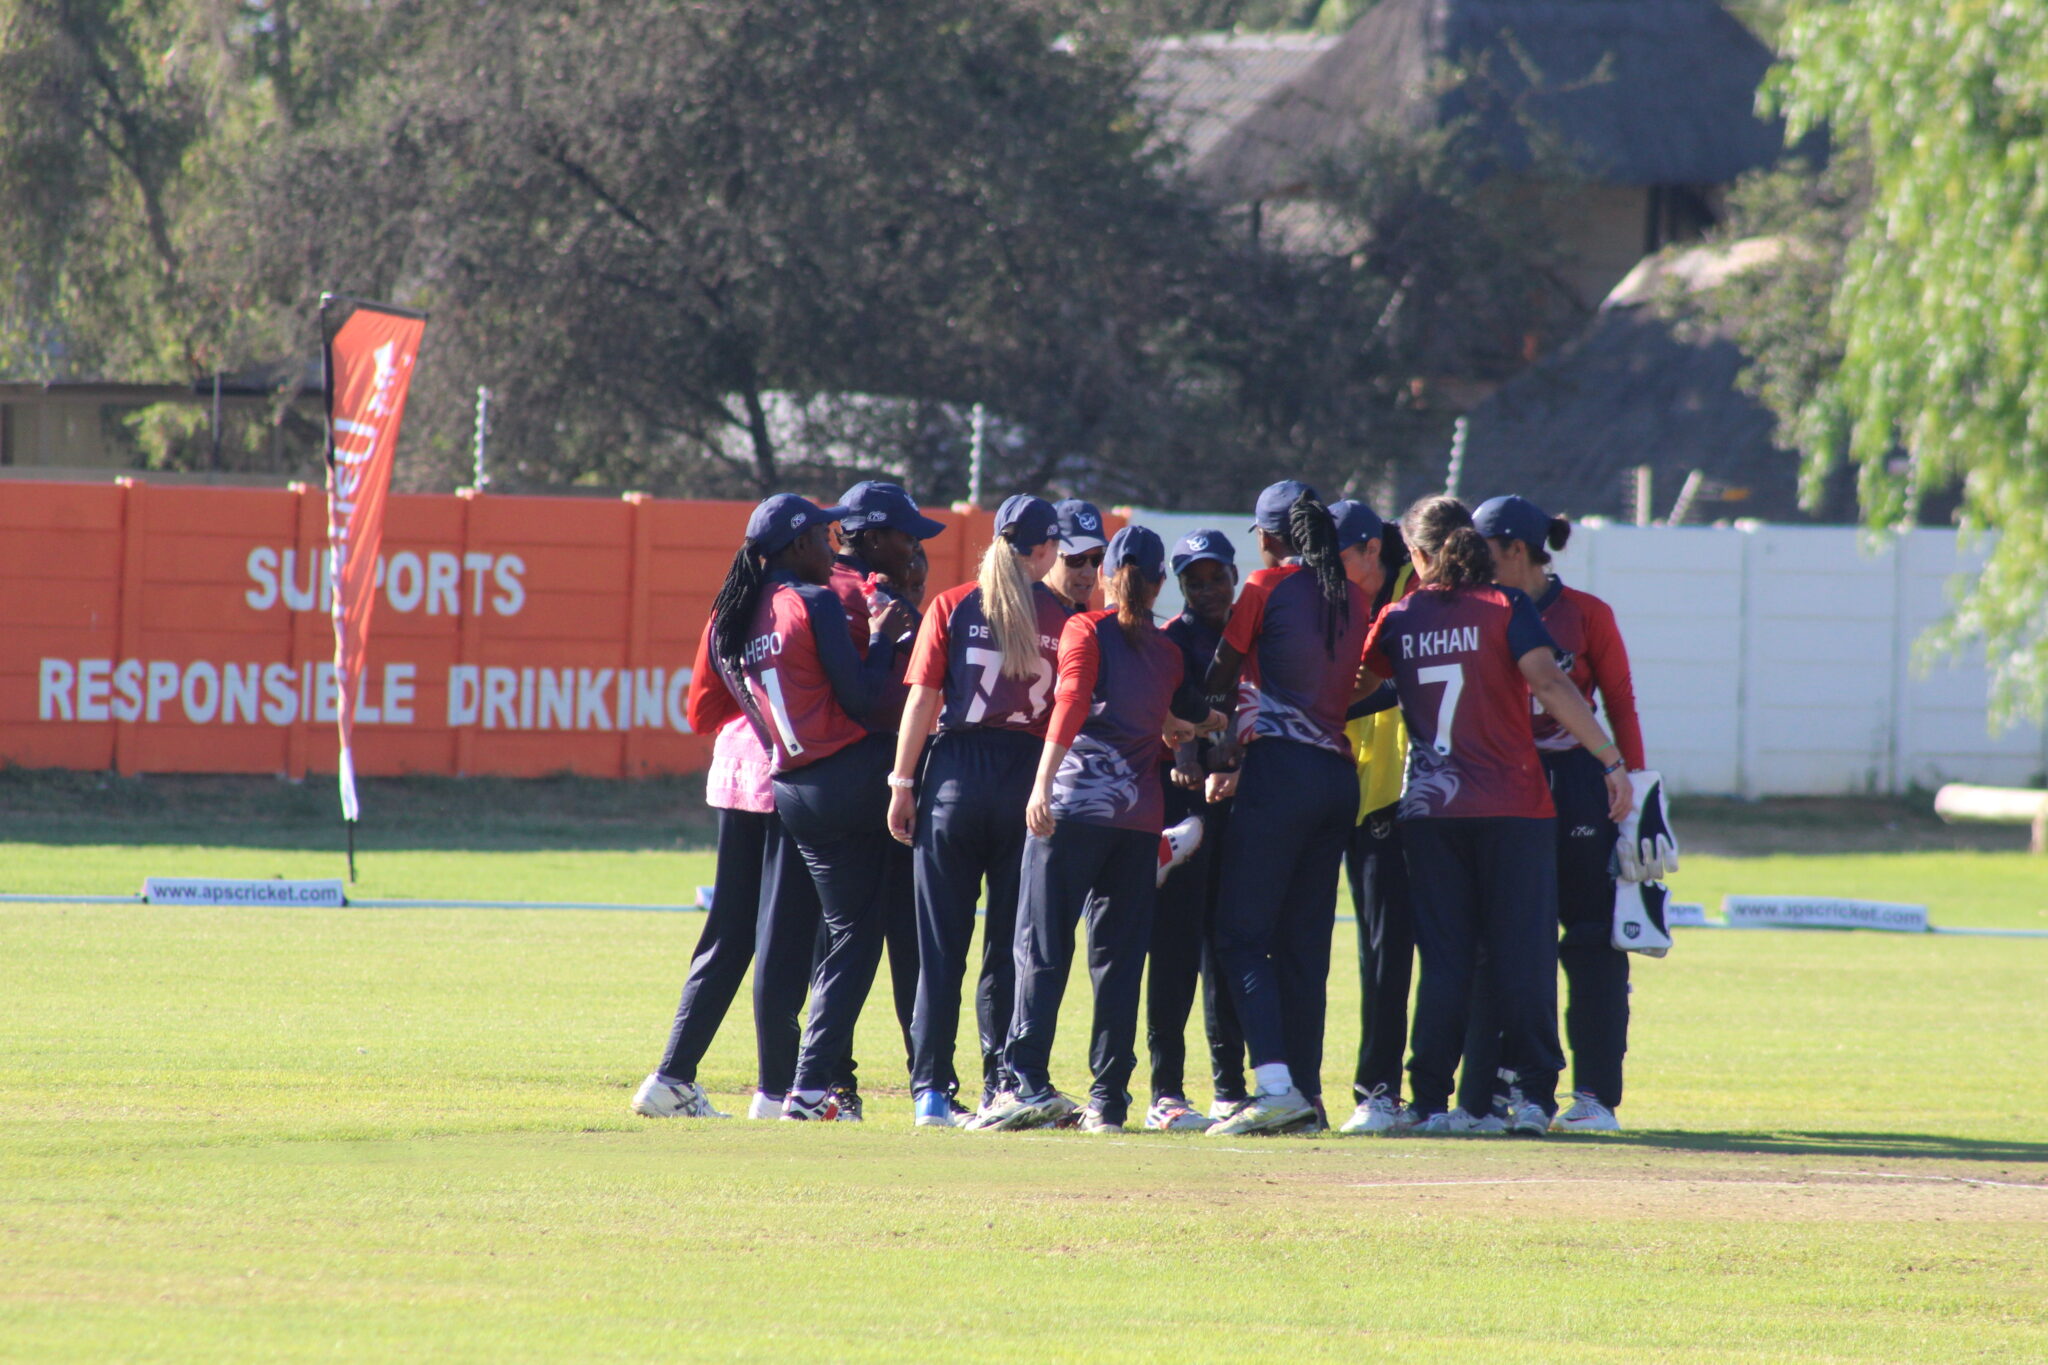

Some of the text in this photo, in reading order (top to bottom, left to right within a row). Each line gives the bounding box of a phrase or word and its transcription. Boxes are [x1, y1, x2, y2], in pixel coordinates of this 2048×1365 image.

[245, 546, 526, 616] SUORTS
[1401, 626, 1479, 659] R KHAN
[38, 657, 416, 726] RESPONSIBLE
[1417, 663, 1464, 756] 7
[153, 884, 338, 903] www.apscricket.com
[1733, 902, 1921, 925] www.apscricket.com
